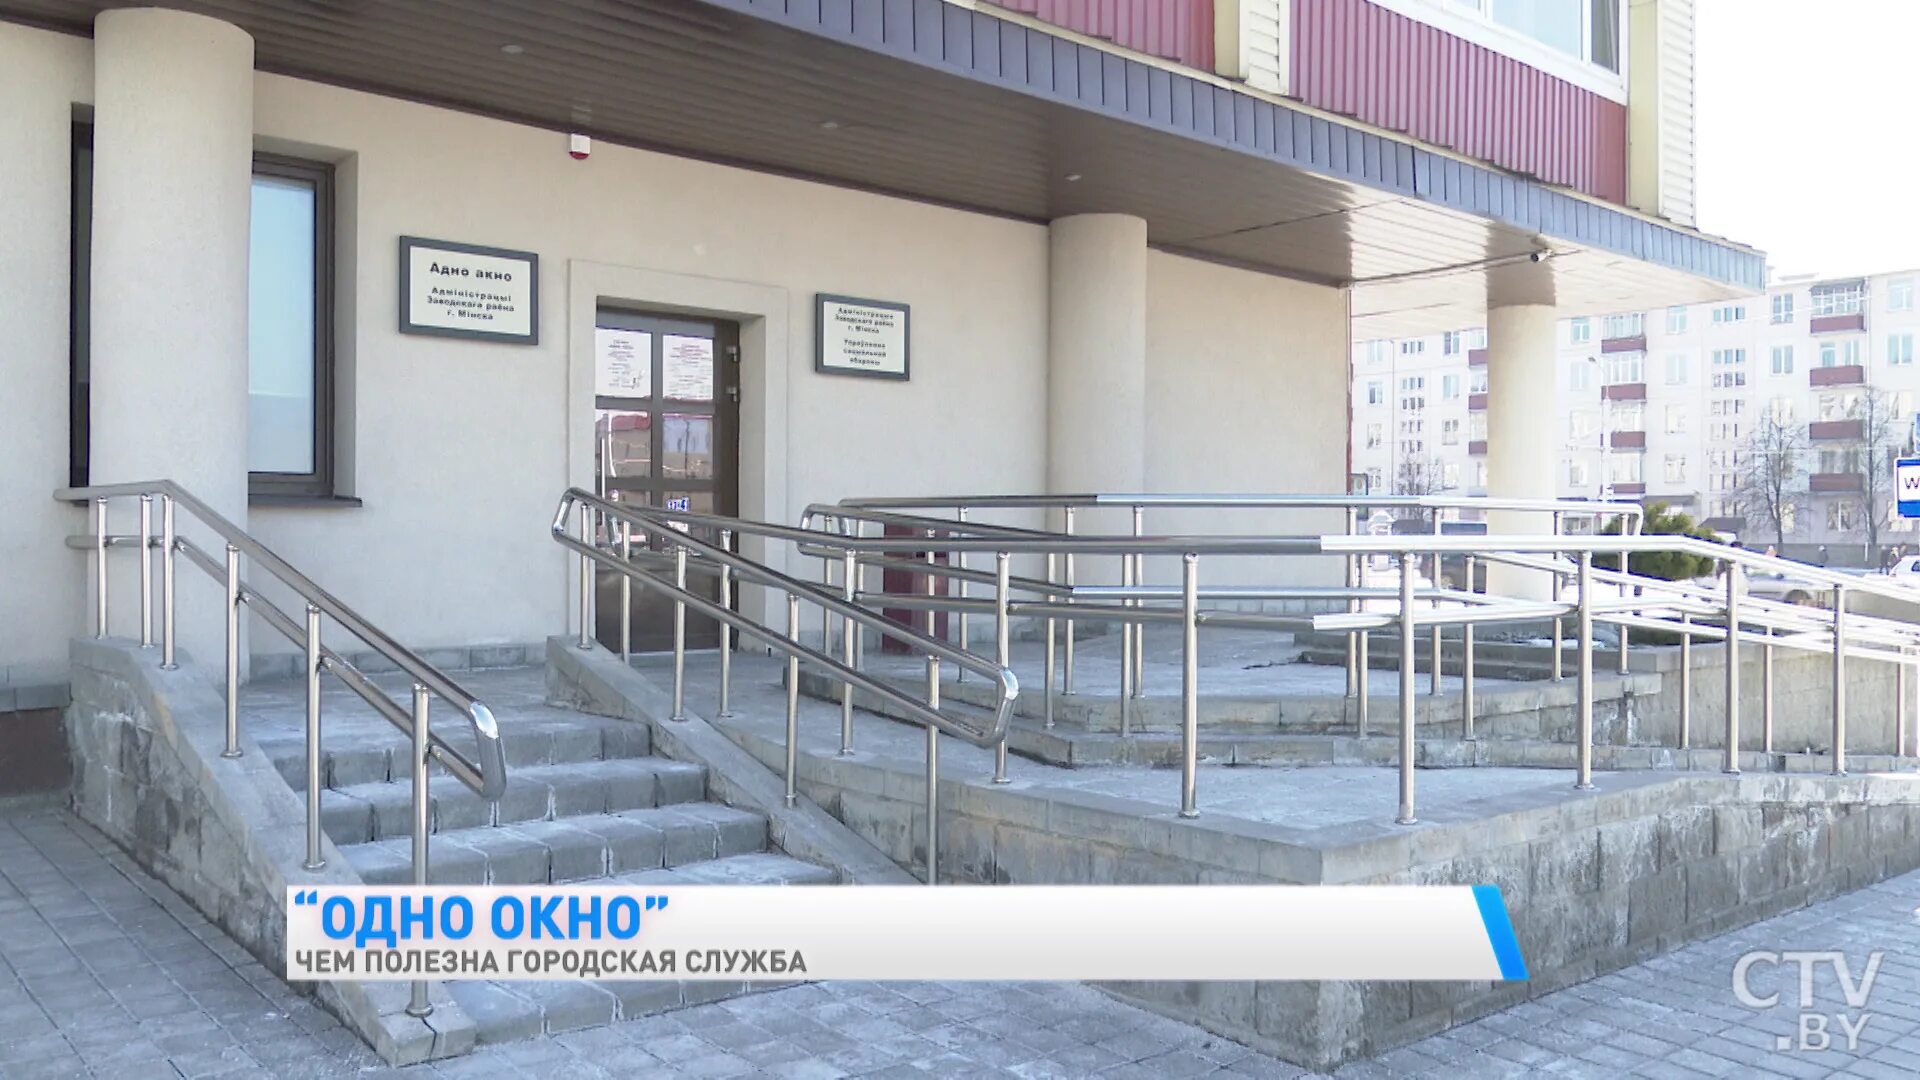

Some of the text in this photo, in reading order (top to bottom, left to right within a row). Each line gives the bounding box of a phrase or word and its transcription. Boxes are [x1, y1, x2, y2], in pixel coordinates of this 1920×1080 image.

[430, 262, 512, 282] Адно акно
[427, 296, 515, 312] Заводскага раёна
[458, 309, 493, 320] Мінска
